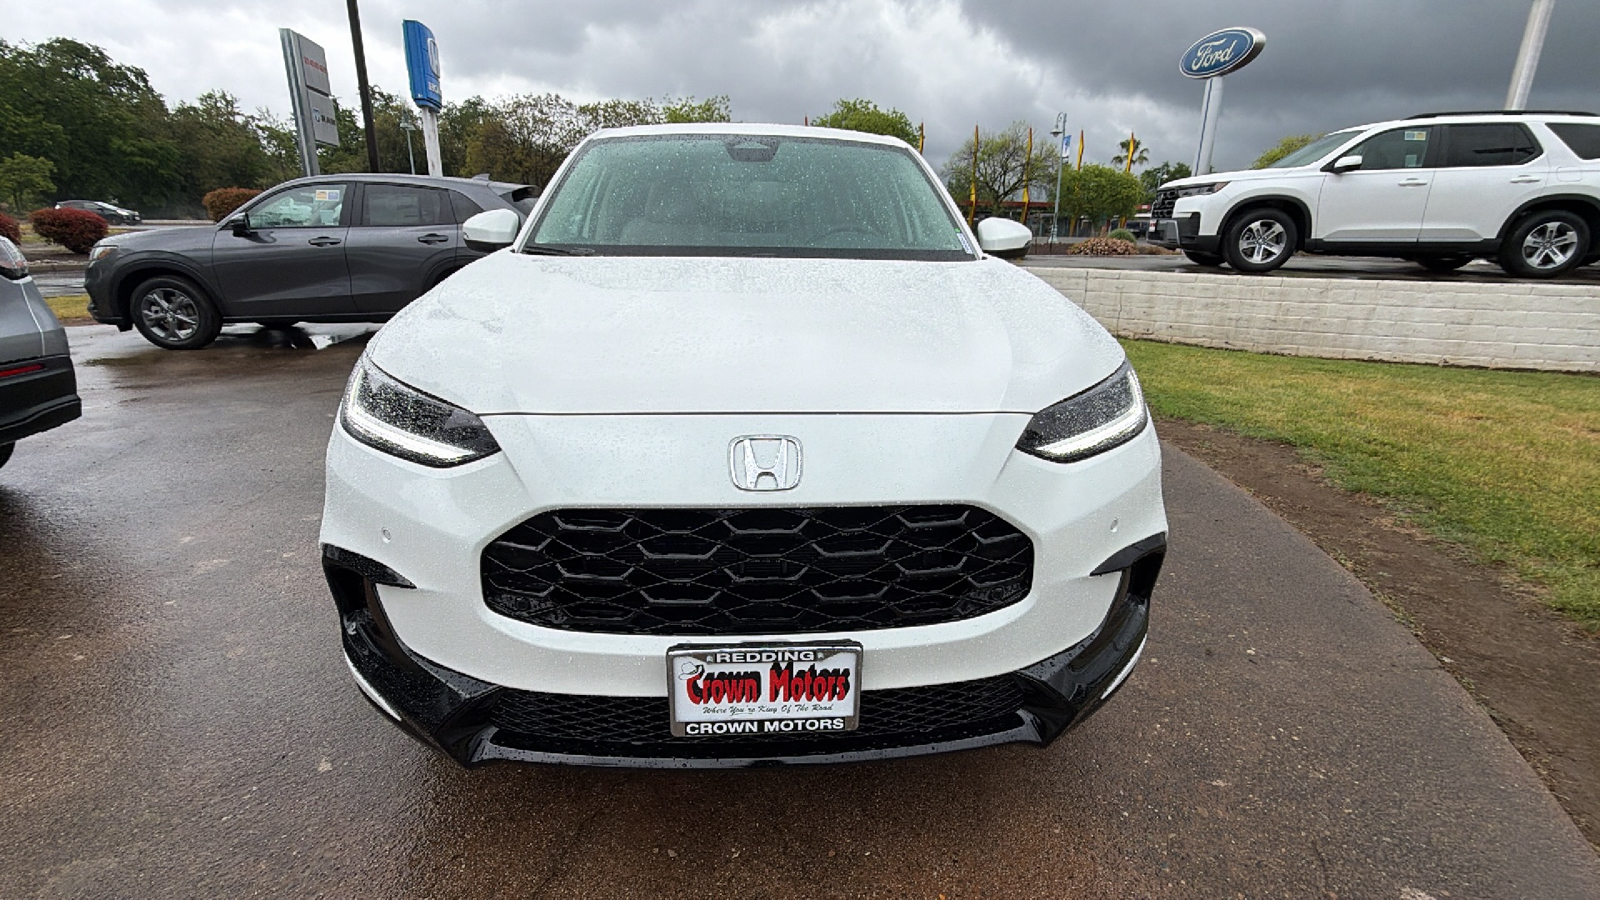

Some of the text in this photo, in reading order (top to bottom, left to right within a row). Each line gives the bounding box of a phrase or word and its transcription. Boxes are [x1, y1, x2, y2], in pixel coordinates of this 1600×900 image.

[1191, 38, 1237, 70] Ford
[716, 651, 815, 663] REDDING
[686, 662, 850, 705] Crown Motors
[702, 706, 727, 714] Where
[758, 705, 778, 714] King
[781, 704, 792, 714] Of
[794, 703, 809, 713] The
[811, 704, 834, 712] Road
[686, 718, 844, 735] CROWN MOTORS
